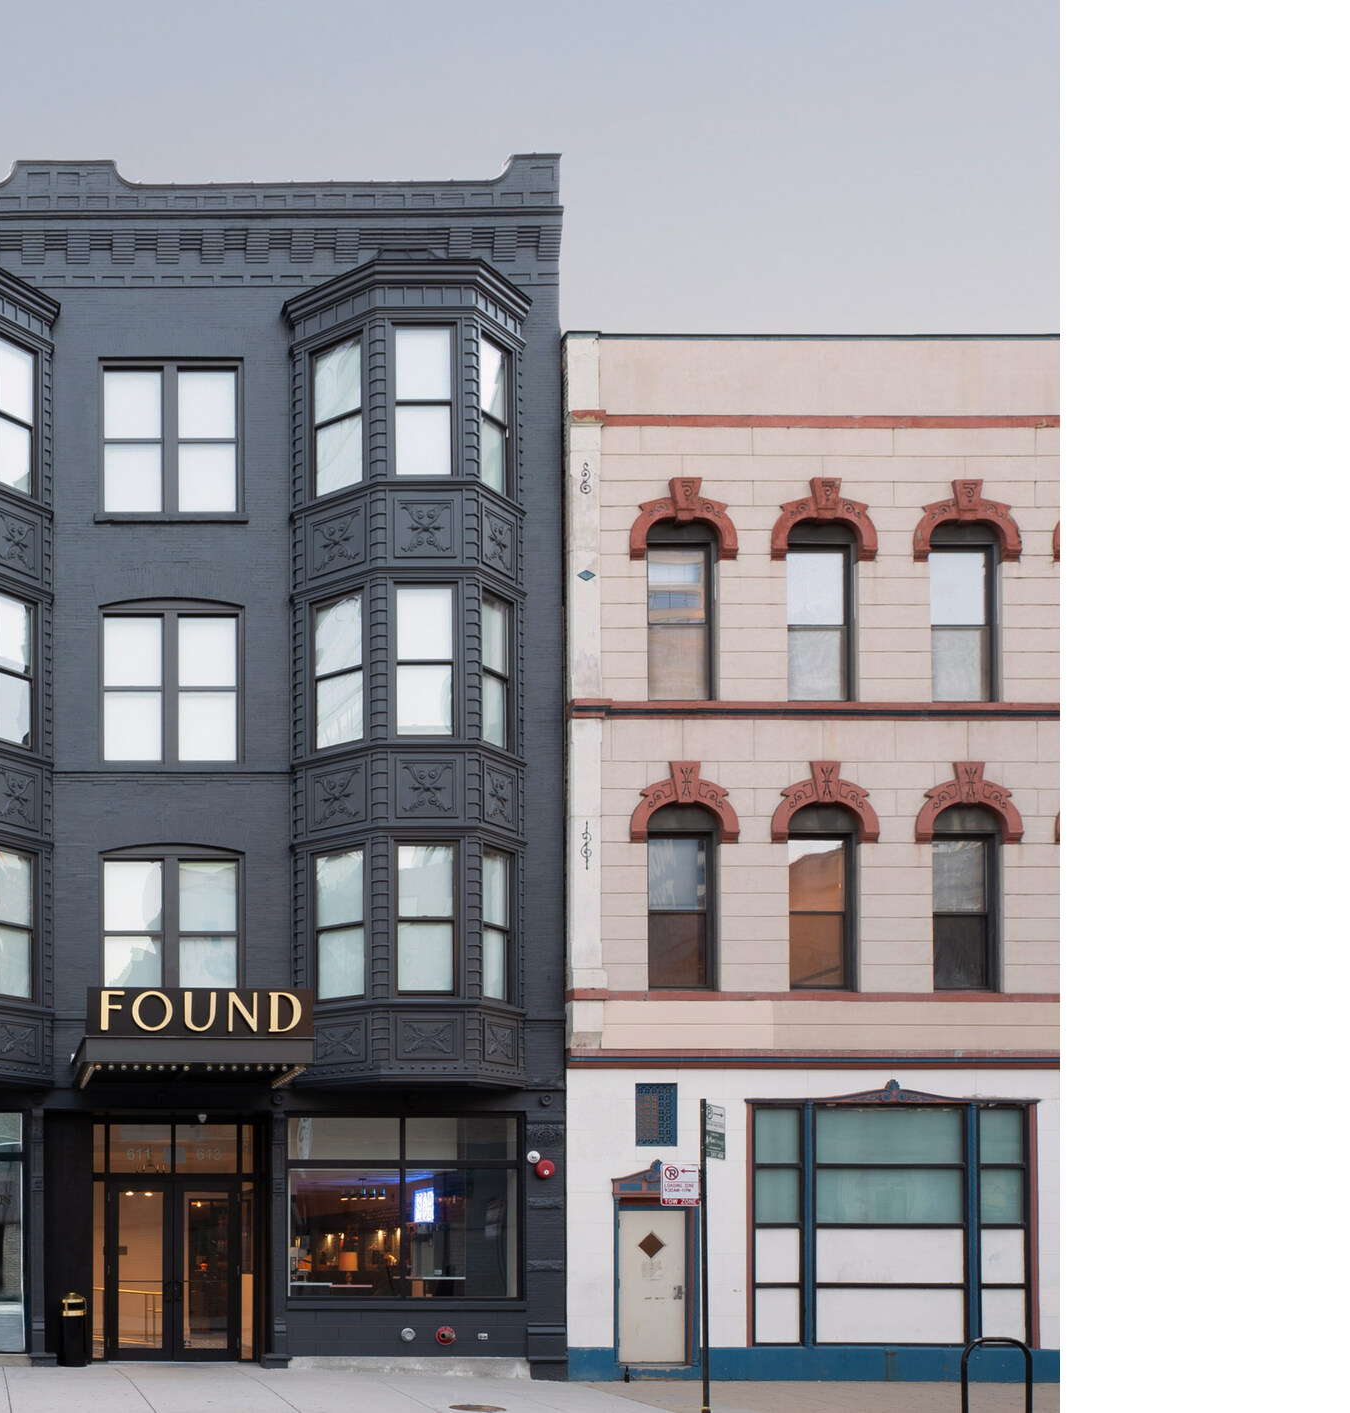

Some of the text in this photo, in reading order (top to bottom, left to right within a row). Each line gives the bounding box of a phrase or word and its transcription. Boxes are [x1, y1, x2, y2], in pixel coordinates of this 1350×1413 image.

[100, 990, 302, 1033] FOUND
[126, 1147, 151, 1161] 611
[196, 1147, 221, 1161] 613
